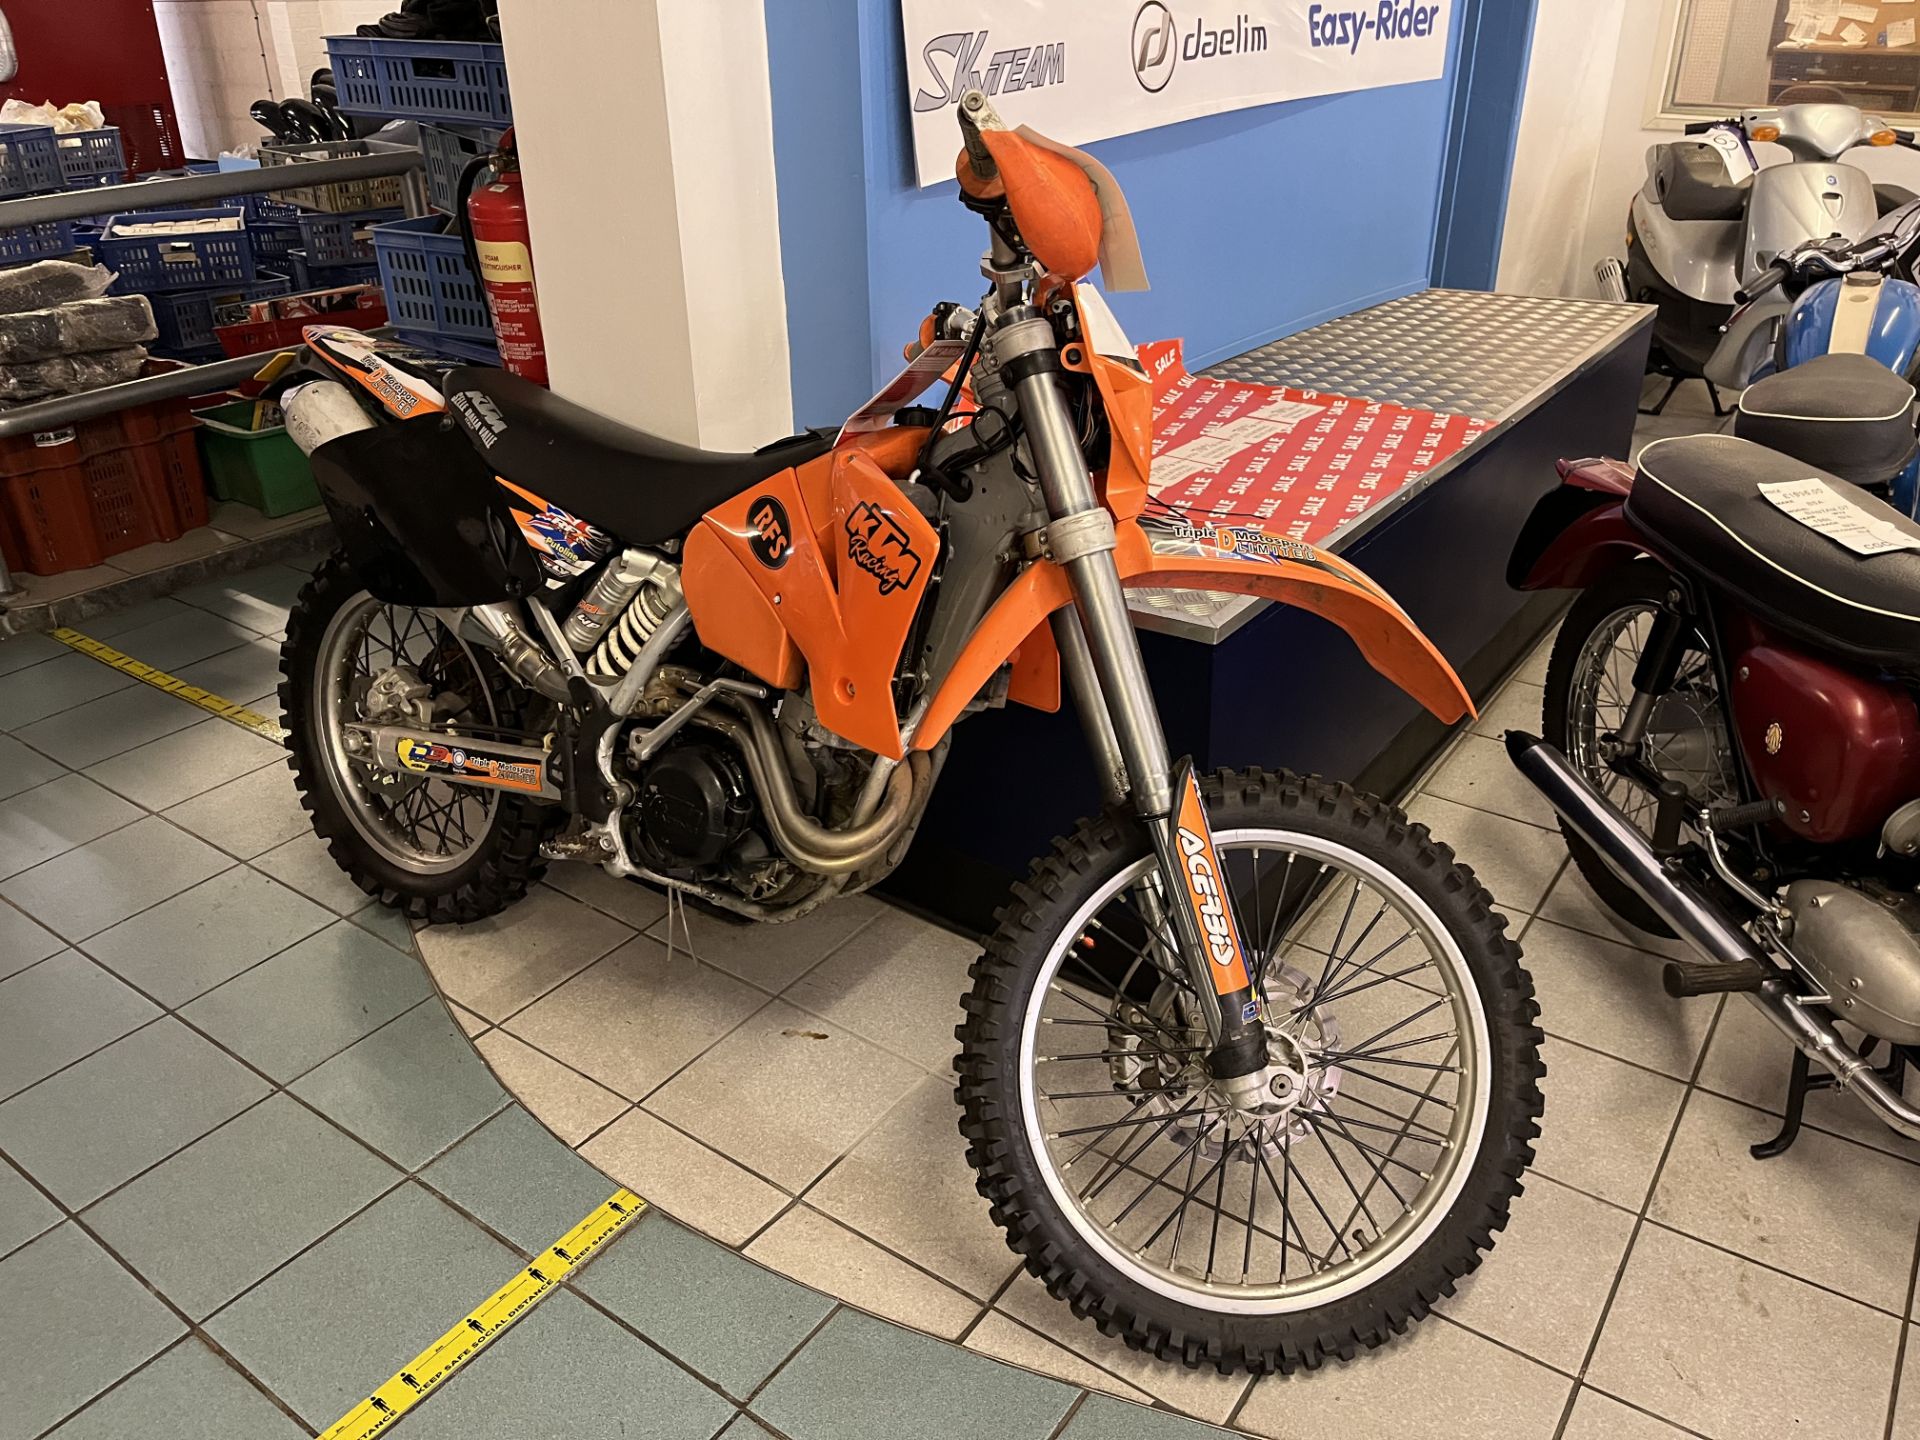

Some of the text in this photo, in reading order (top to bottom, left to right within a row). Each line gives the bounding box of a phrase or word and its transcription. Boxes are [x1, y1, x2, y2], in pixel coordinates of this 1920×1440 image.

[1182, 14, 1268, 61] daelim
[1308, 0, 1440, 55] Easy-Rider
[1155, 349, 1175, 375] SALE
[464, 390, 508, 434] KTM
[1160, 389, 1183, 404] SALE
[1180, 407, 1203, 419] SALE
[1196, 391, 1218, 404] SALE
[1215, 405, 1239, 419] SALE
[1232, 390, 1254, 404] SALE
[450, 391, 498, 449] SELLE DALLA VALLE
[1421, 432, 1443, 448] SALE
[1430, 412, 1450, 430] SALE
[1208, 499, 1238, 519] SALE
[1227, 477, 1255, 496] SALE
[1246, 456, 1271, 474] SALE
[1261, 437, 1286, 454] SALE
[1253, 498, 1282, 518] SALE
[1272, 476, 1298, 493] SALE
[1287, 455, 1312, 472] SALE
[1302, 436, 1326, 452] SALE
[1315, 418, 1337, 433] SALE
[1327, 400, 1349, 416] SALE
[1286, 520, 1312, 541] ALE
[1300, 496, 1327, 517] SALE
[1315, 474, 1341, 493] SALE
[1329, 453, 1353, 471] SALE
[1342, 434, 1366, 451] SALE
[1354, 416, 1376, 432] SALE
[1345, 415, 1413, 513] SALE SALE SALE SALE SALE
[1412, 450, 1435, 466] SALE
[1184, 477, 1213, 496] SALE
[545, 536, 579, 561] Putoline
[753, 504, 788, 560] RFS
[846, 501, 921, 590] KTM
[1173, 525, 1313, 552] Triple D Motosport
[1236, 541, 1318, 561] LIMITED
[849, 534, 901, 596] Racing
[470, 756, 490, 769] Triple
[498, 761, 536, 775] Motosport
[568, 1201, 647, 1266] KEEP SAFE SOCIAL
[416, 1278, 554, 1395] KEEP SAFE SOCIAL DISTANCE
